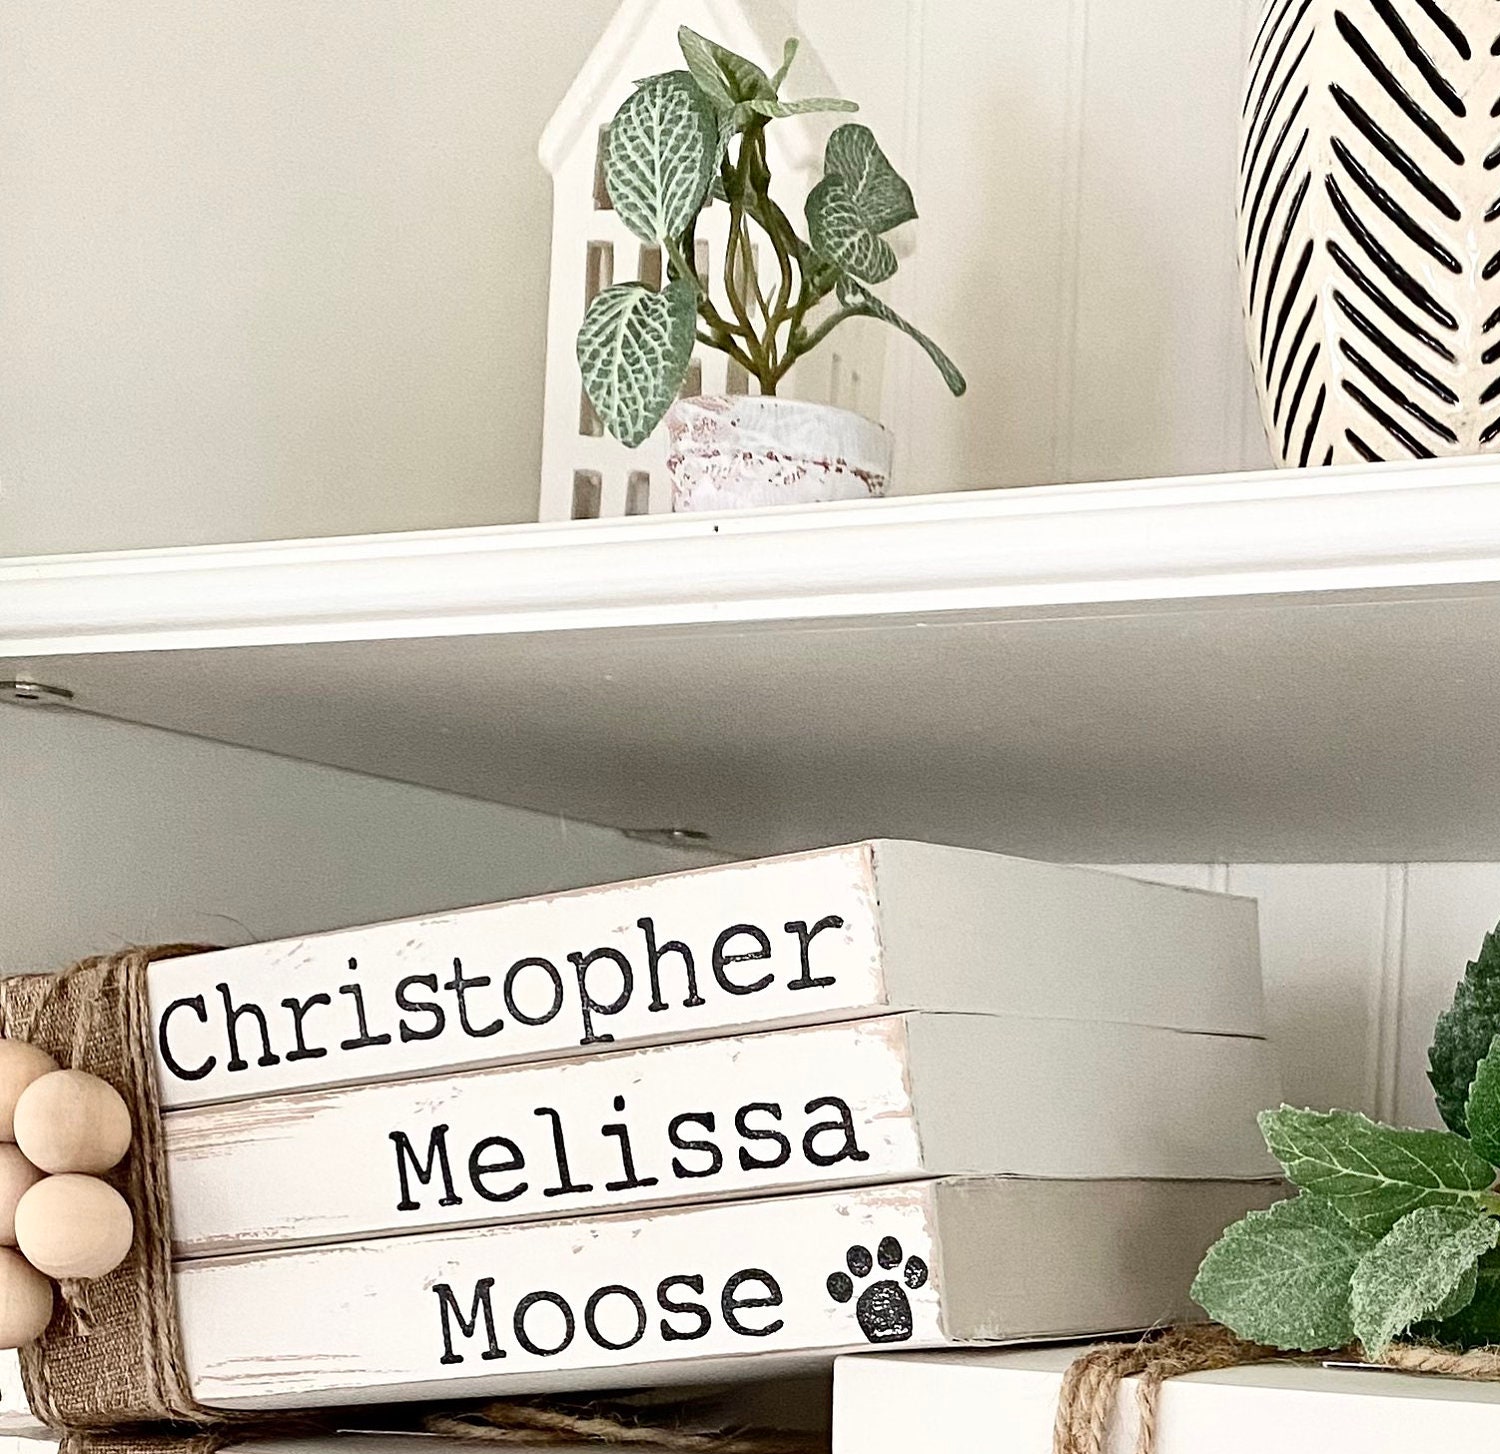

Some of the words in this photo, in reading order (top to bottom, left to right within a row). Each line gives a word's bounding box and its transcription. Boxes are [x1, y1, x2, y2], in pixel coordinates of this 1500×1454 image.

[157, 912, 846, 1083] Christopher
[387, 1095, 871, 1213] Melissa
[431, 1267, 786, 1366] Moose
